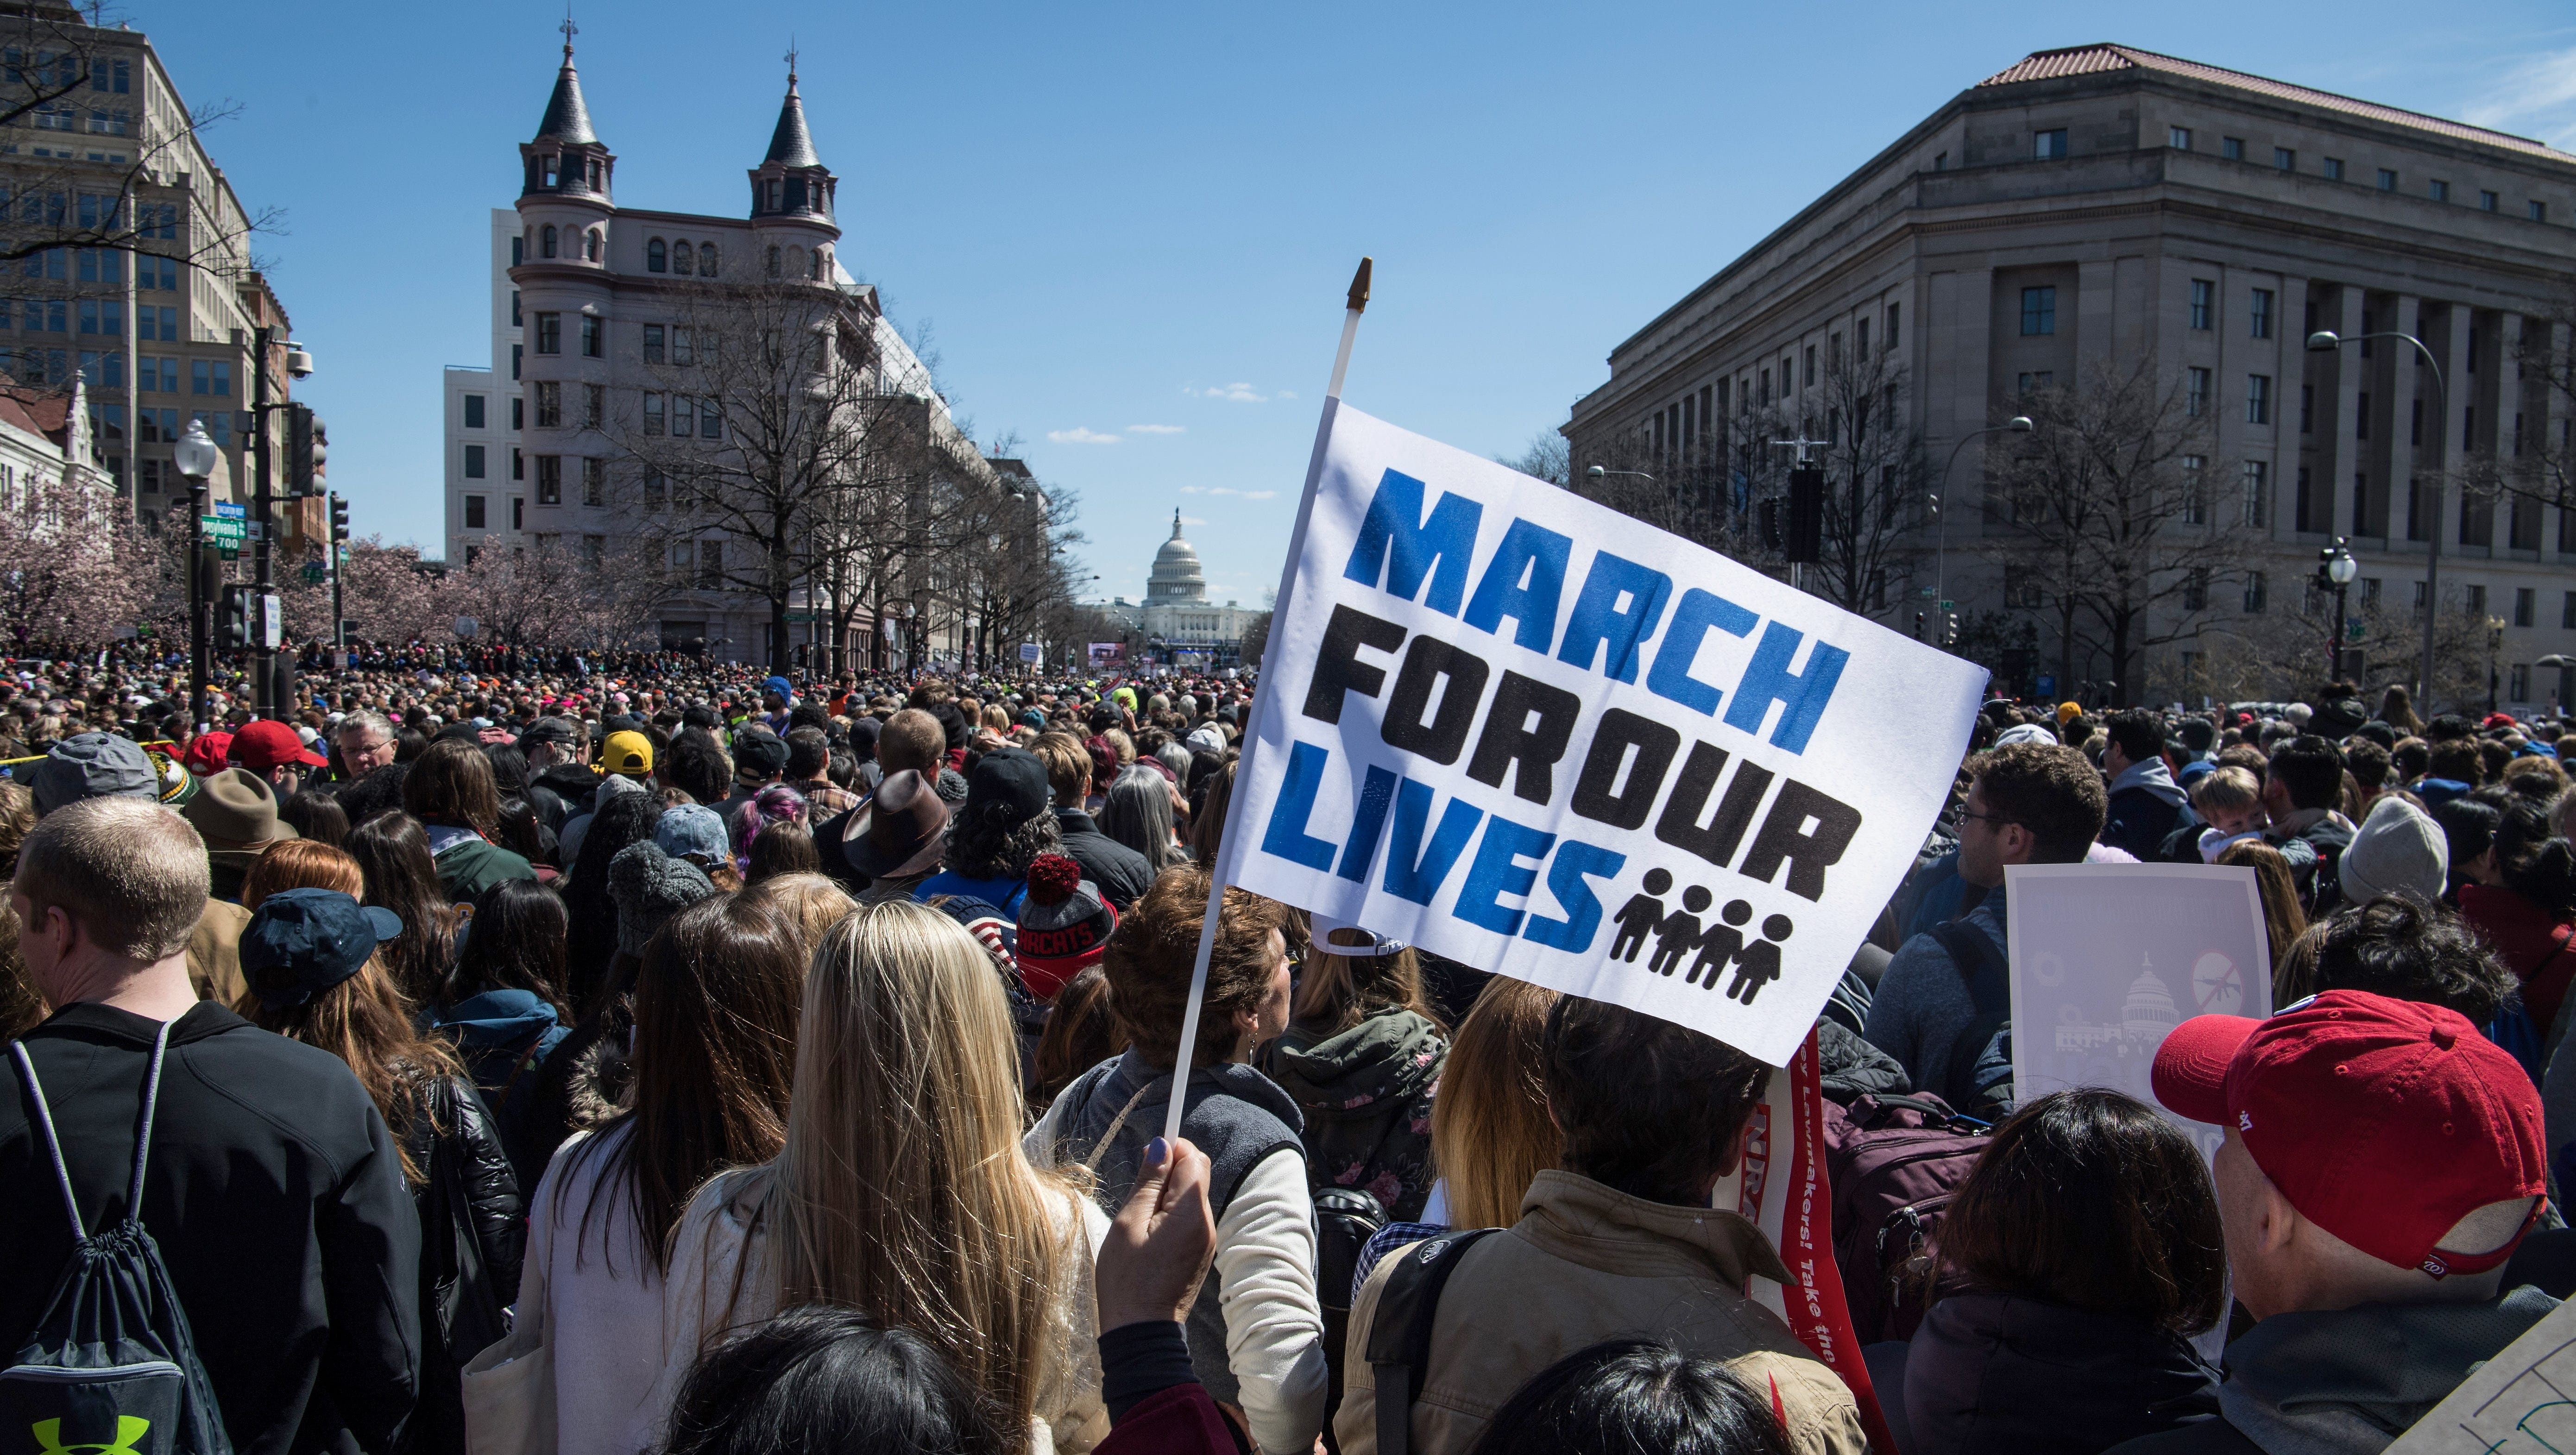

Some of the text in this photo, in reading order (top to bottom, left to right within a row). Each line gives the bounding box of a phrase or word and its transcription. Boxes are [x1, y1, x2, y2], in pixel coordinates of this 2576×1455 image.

[218, 537, 238, 549] 700
[1344, 468, 1850, 755] MARCH
[1302, 603, 1862, 903] FOR OUR
[1261, 740, 1627, 954] LIVES
[1017, 922, 1094, 955] ARCATS
[147, 1033, 167, 1103] UNDER ARMOUR
[1800, 1086, 1816, 1250] Lawmakers!
[1800, 1259, 1822, 1318] Take
[1814, 1324, 1836, 1363] the
